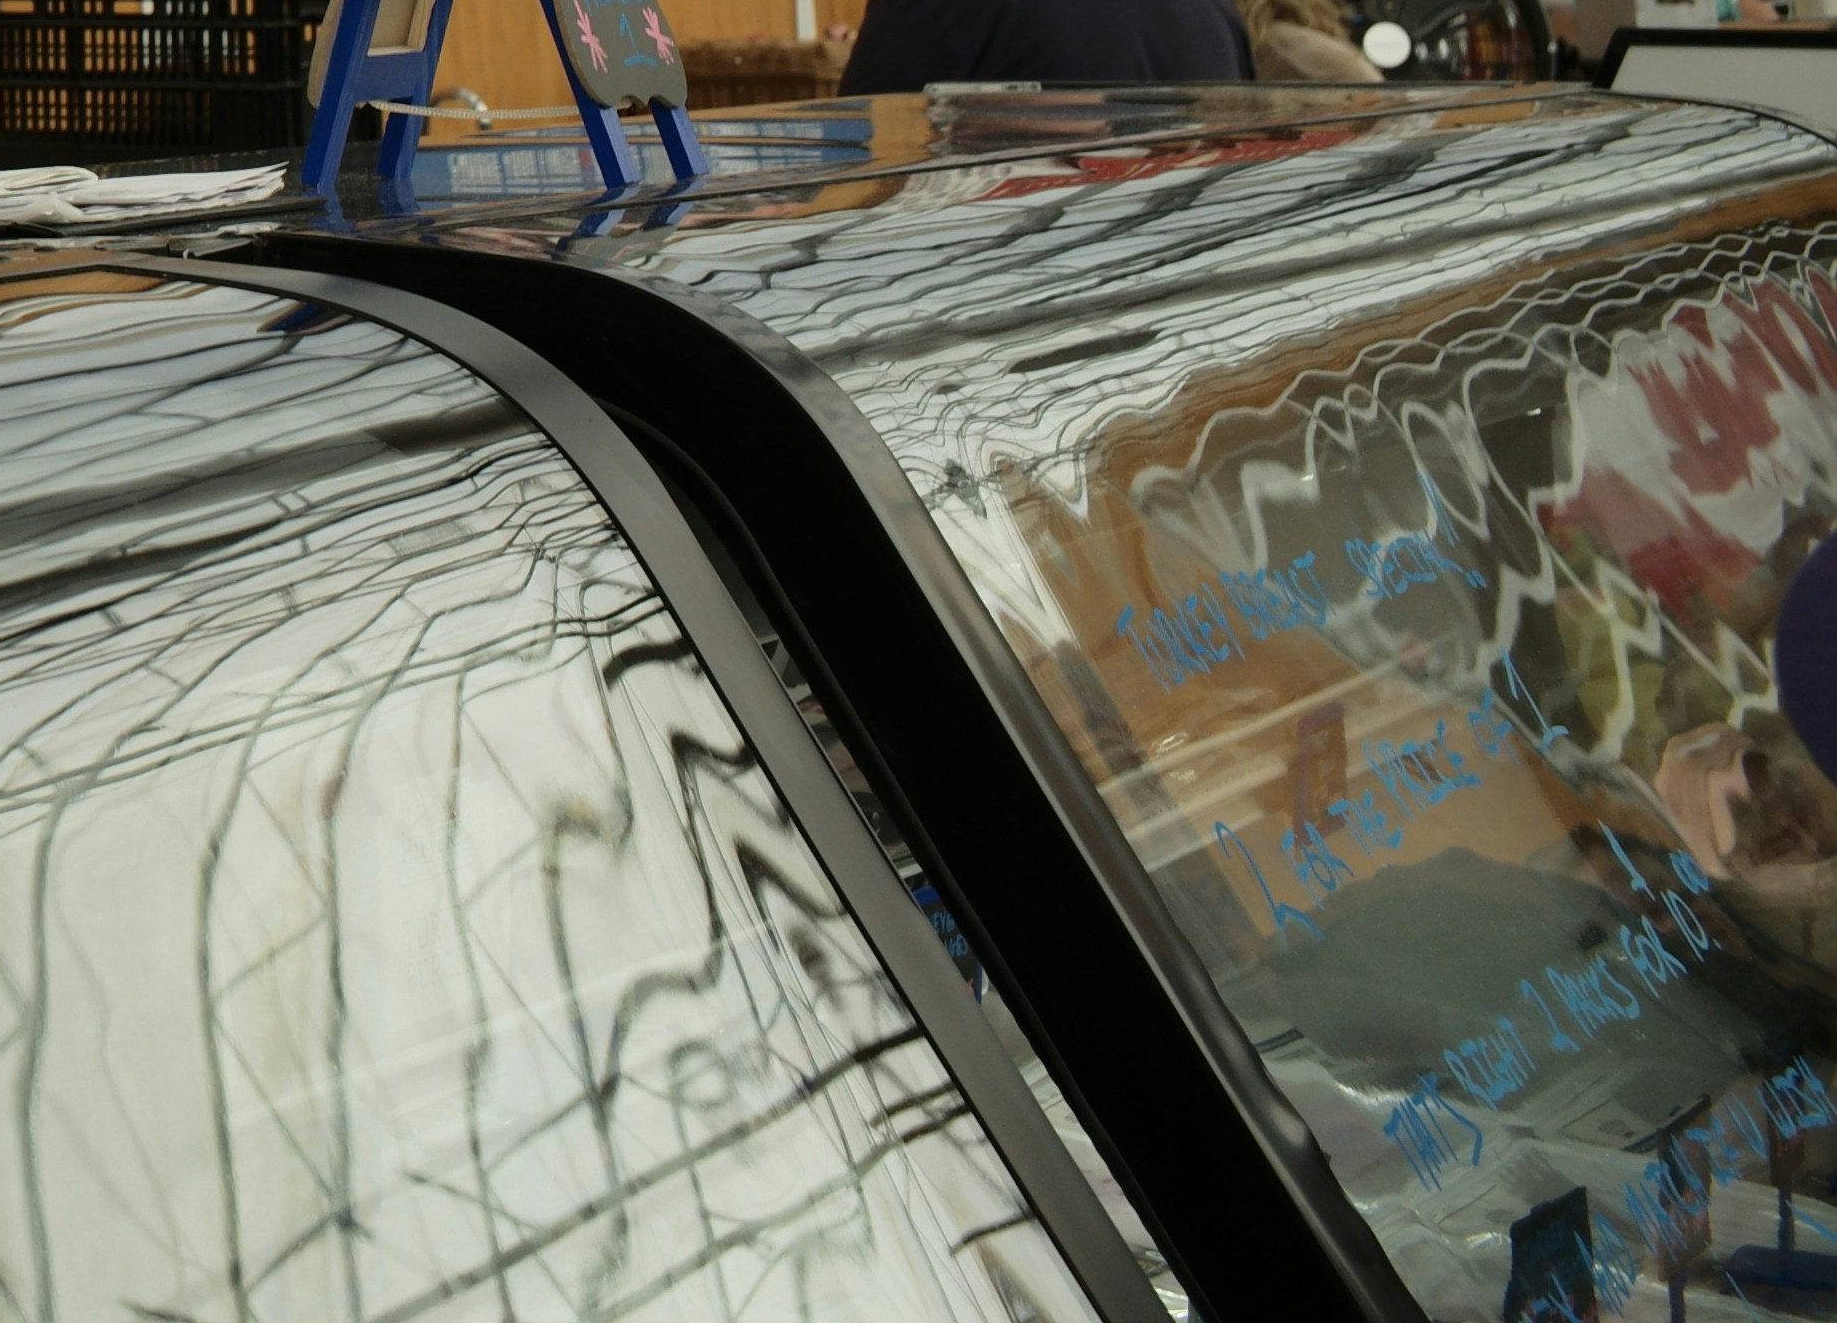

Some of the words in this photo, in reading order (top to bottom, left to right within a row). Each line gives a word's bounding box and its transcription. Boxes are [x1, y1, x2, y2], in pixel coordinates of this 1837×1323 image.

[1117, 604, 1246, 695] TURKEY
[1362, 718, 1481, 822] PRICE
[1443, 1016, 1537, 1113] RIGHT
[1545, 955, 1642, 1039] PACKS
[1620, 914, 1688, 999] FOR
